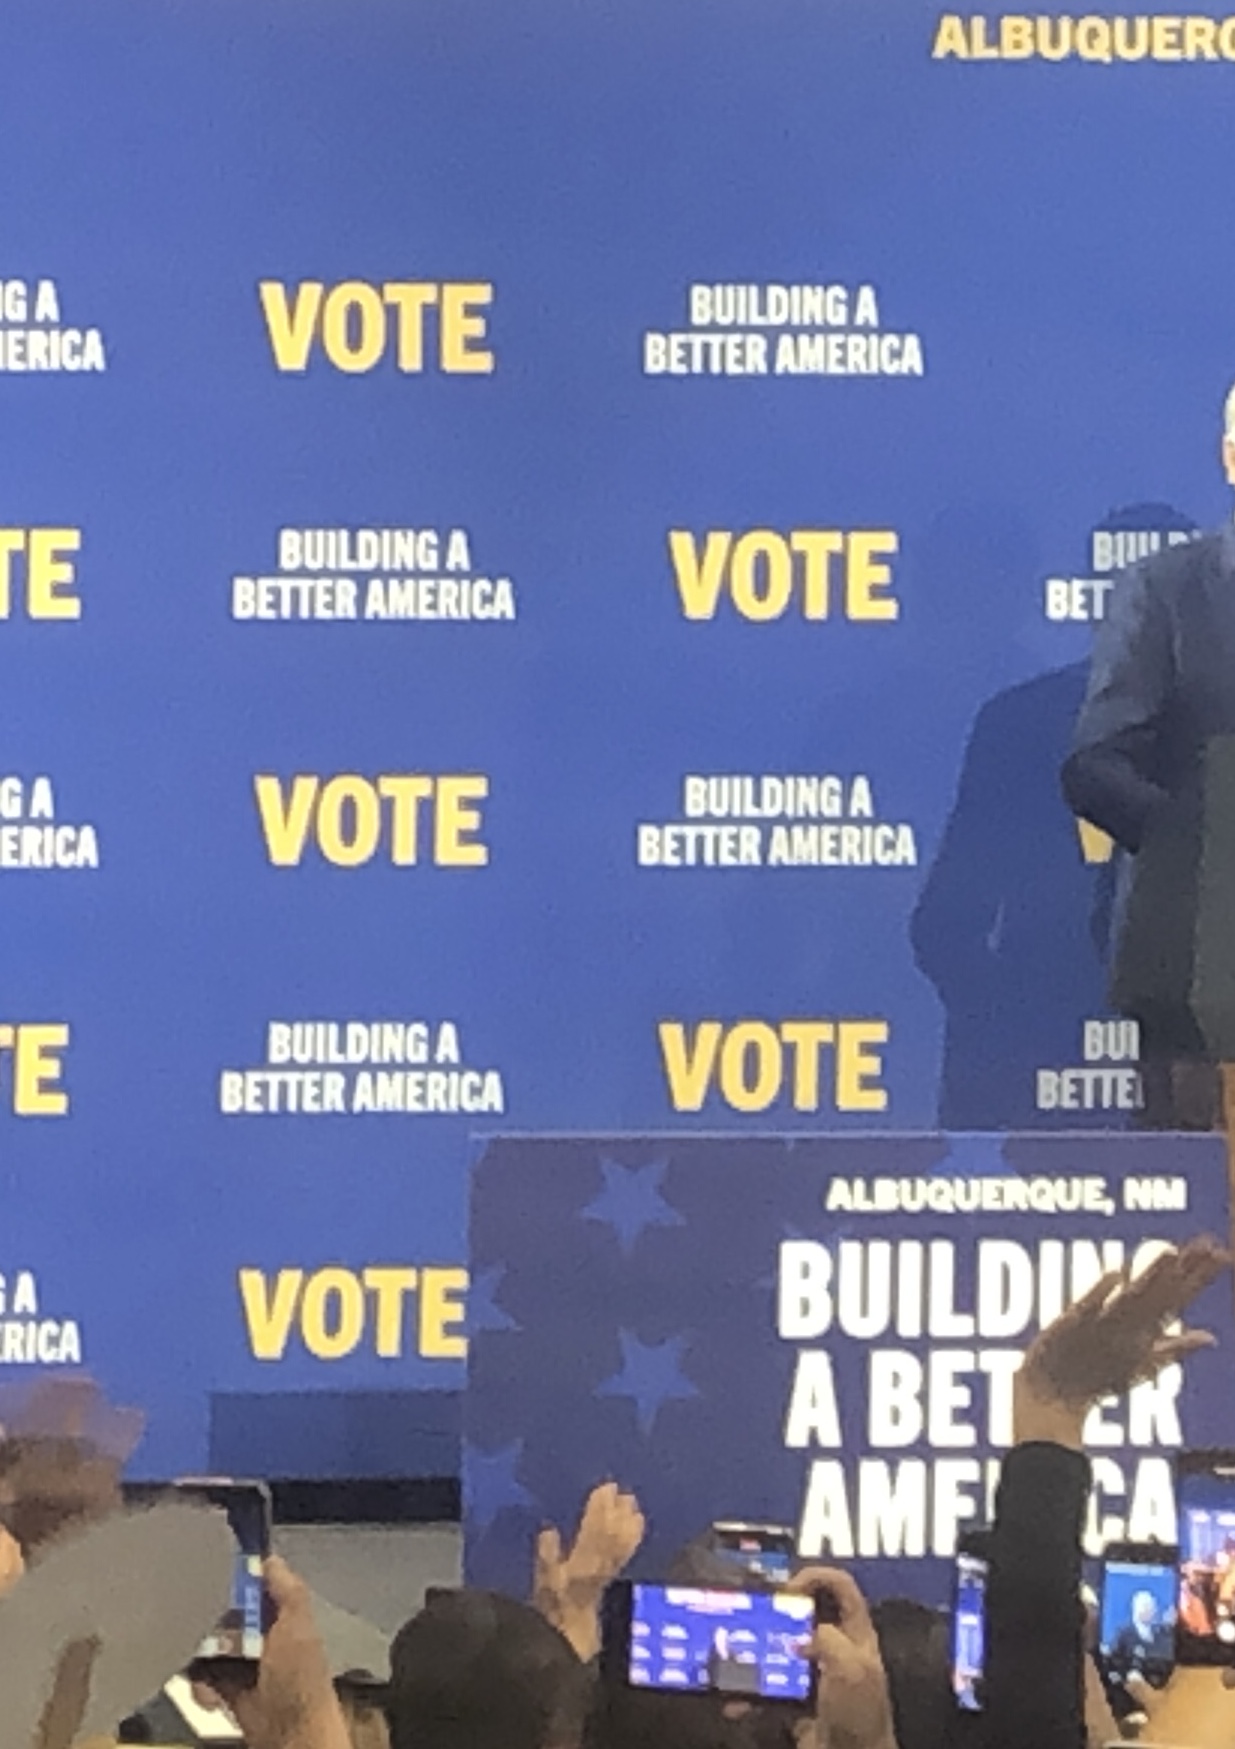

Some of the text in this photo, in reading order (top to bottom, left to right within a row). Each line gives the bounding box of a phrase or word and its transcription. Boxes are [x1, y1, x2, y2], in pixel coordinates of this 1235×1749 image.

[34, 279, 60, 324] A
[690, 284, 879, 328] BUILDING A
[259, 281, 494, 373] VOTE
[0, 328, 106, 372] ERICA
[644, 332, 924, 376] BETTER AMERICA
[279, 528, 471, 572] BUILDING A
[669, 529, 899, 622] VOTE
[232, 576, 516, 620] BETTER AMERICA
[1045, 578, 1116, 621] BET
[28, 776, 54, 821] A
[684, 775, 873, 819] BUILDING A
[254, 774, 489, 867] VOTE
[0, 824, 99, 869] ERICA
[638, 823, 917, 867] BETTER AMERICA
[268, 1021, 460, 1065] BUILDING A
[658, 1020, 889, 1112] VOTE
[220, 1070, 504, 1114] BETTER AMERICA
[825, 1176, 1187, 1217] ALBUQUERQUE, NM
[13, 1271, 38, 1316] A
[239, 1266, 470, 1360] VOTE
[0, 1319, 81, 1364] RICA
[784, 1348, 843, 1448] A
